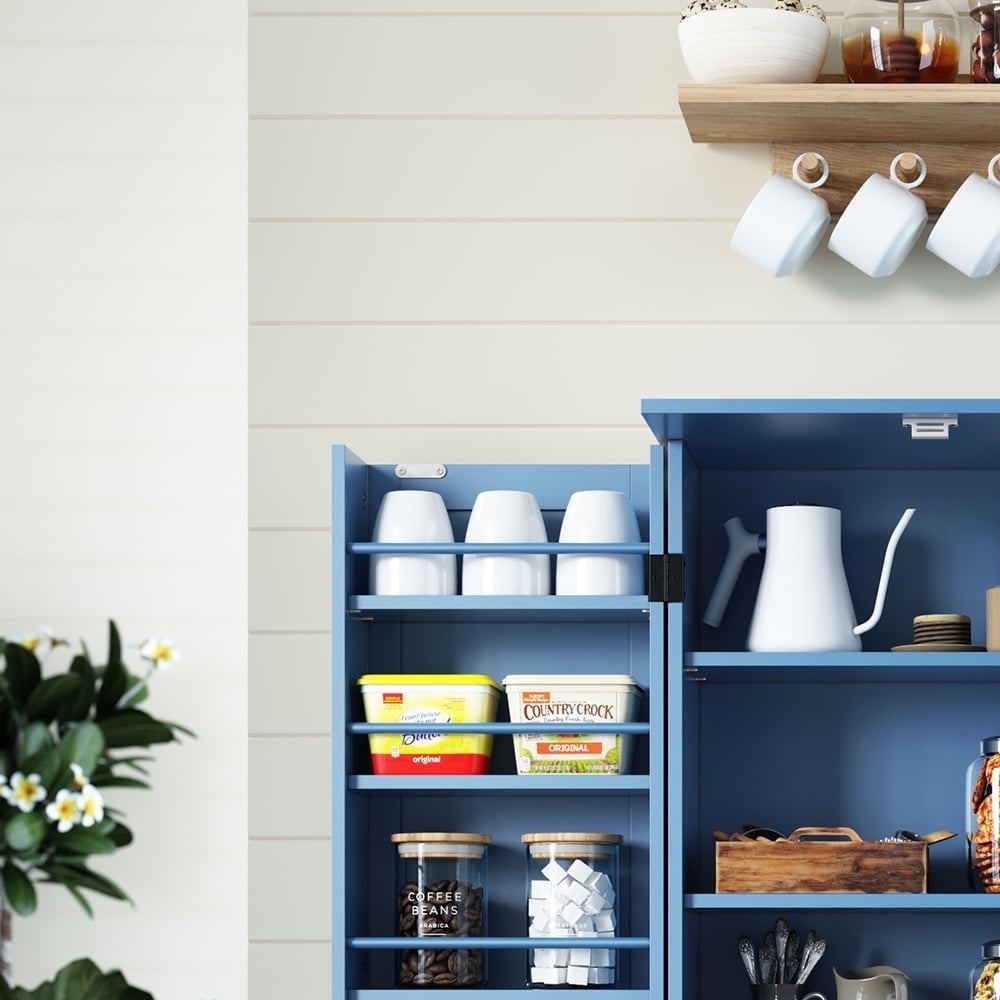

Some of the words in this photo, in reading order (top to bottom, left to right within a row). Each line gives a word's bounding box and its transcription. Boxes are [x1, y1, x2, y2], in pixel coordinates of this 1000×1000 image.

[523, 703, 577, 721] COUNTRY
[577, 703, 614, 720] CROCK
[548, 744, 589, 752] ORIGINAL
[412, 755, 442, 765] original
[408, 891, 462, 902] COFFEE
[412, 905, 458, 915] BEANS
